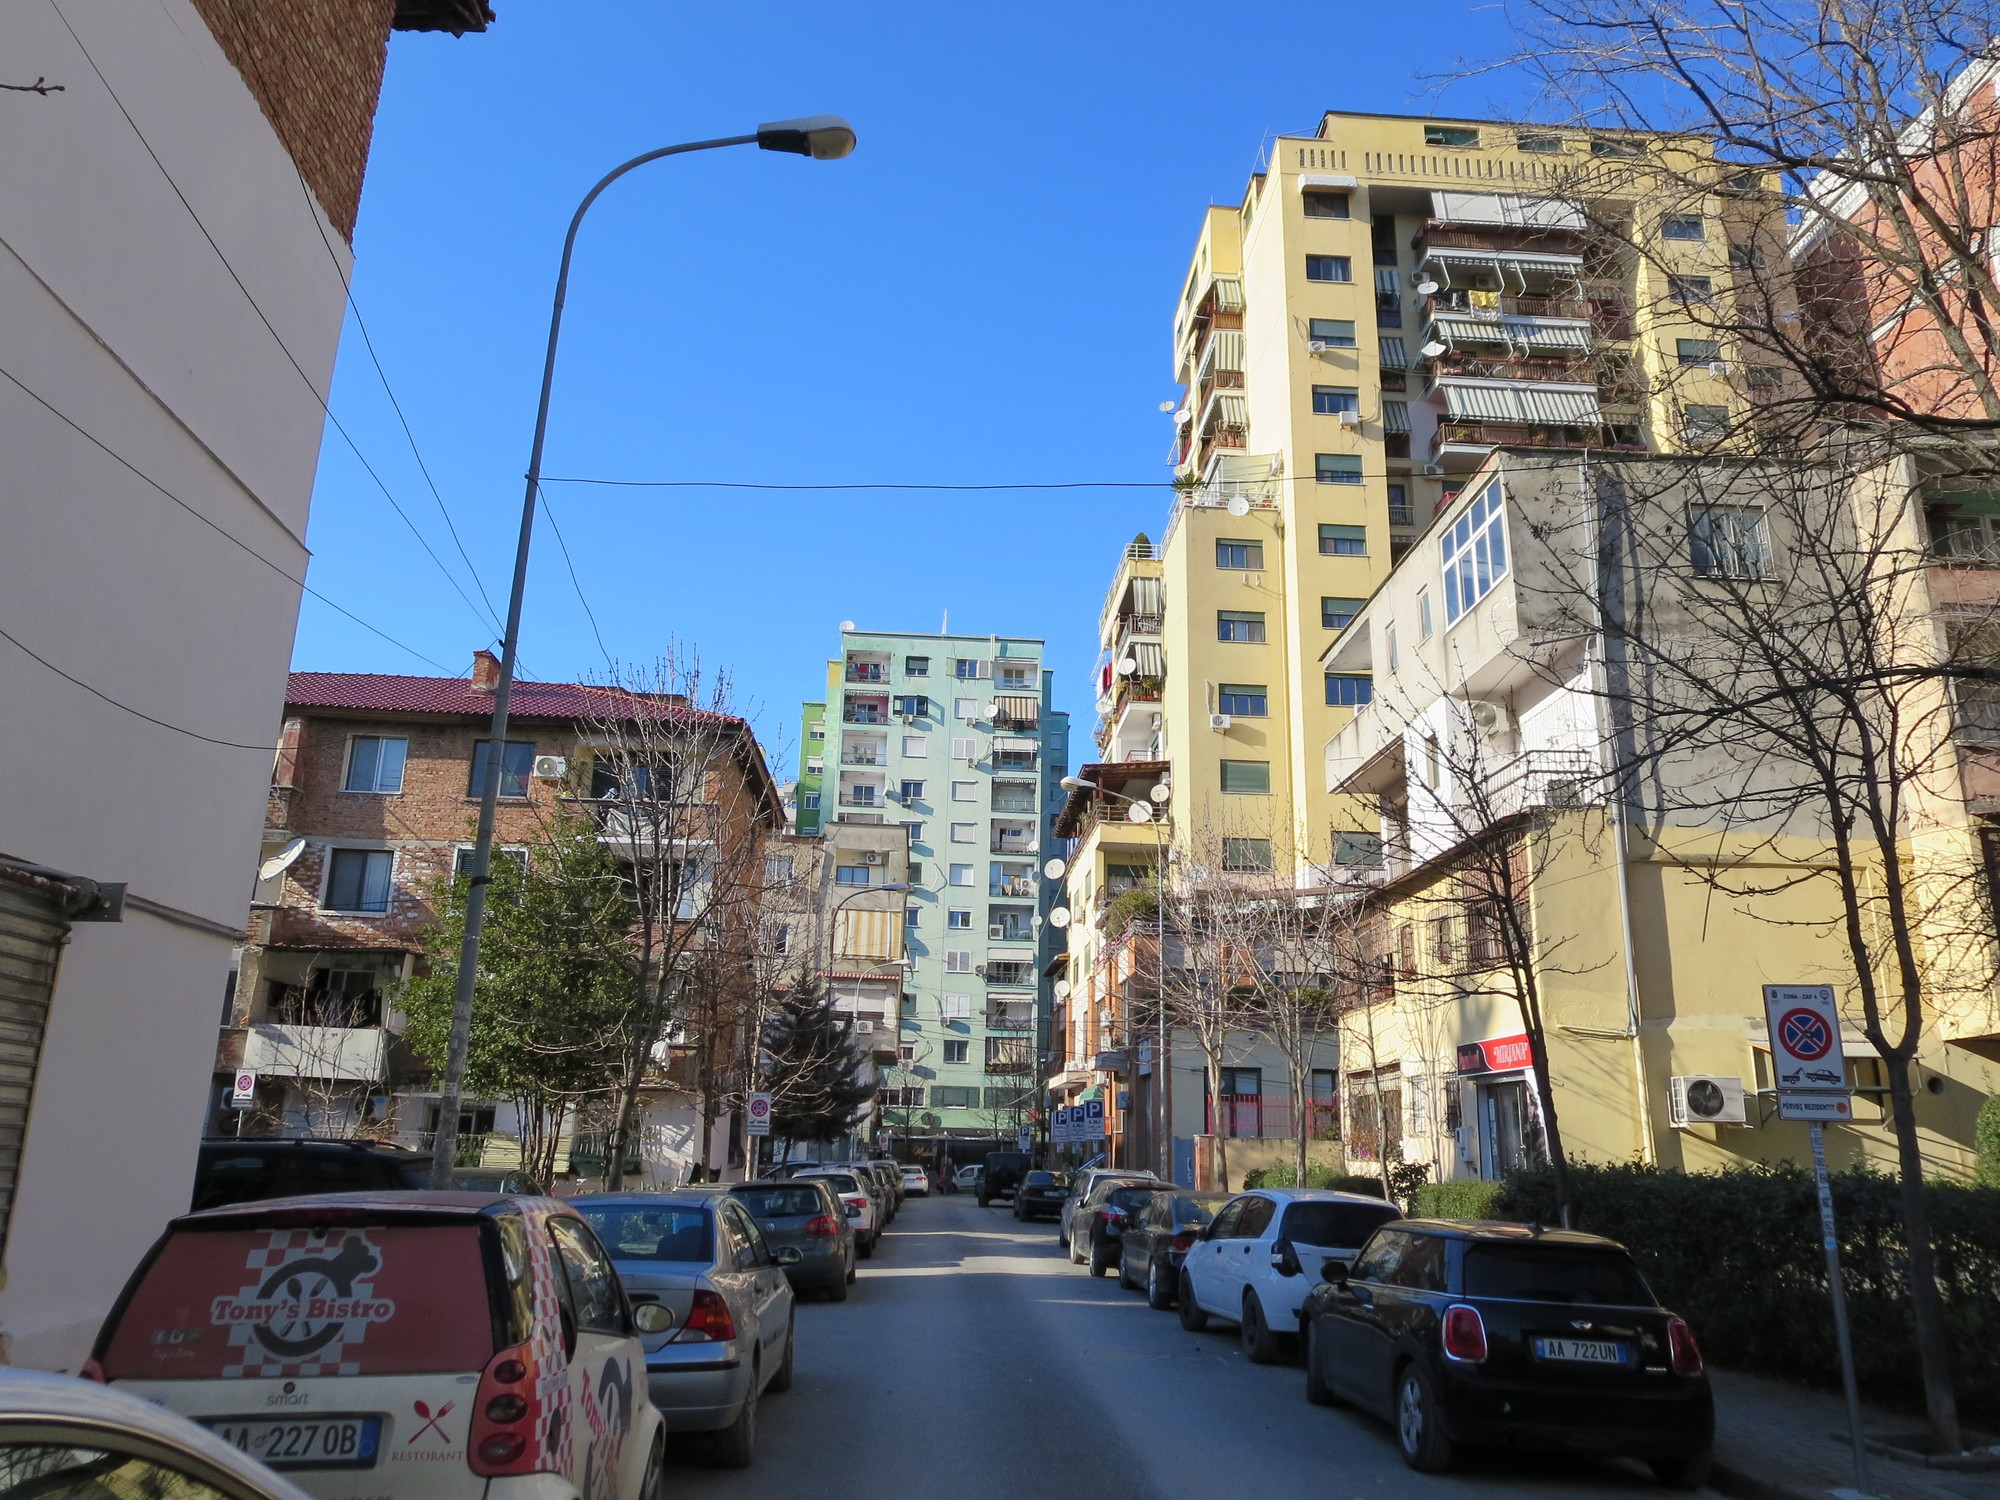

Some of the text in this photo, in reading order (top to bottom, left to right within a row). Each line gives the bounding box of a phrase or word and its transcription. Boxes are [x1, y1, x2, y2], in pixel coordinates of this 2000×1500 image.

[1073, 1108, 1083, 1122] P
[1090, 1102, 1100, 1117] P
[1058, 1112, 1067, 1124] P
[215, 1298, 391, 1327] Tony's Bistro
[1549, 1340, 1565, 1357] AA
[266, 1391, 309, 1406] smart
[391, 1450, 465, 1462] RESTORANT
